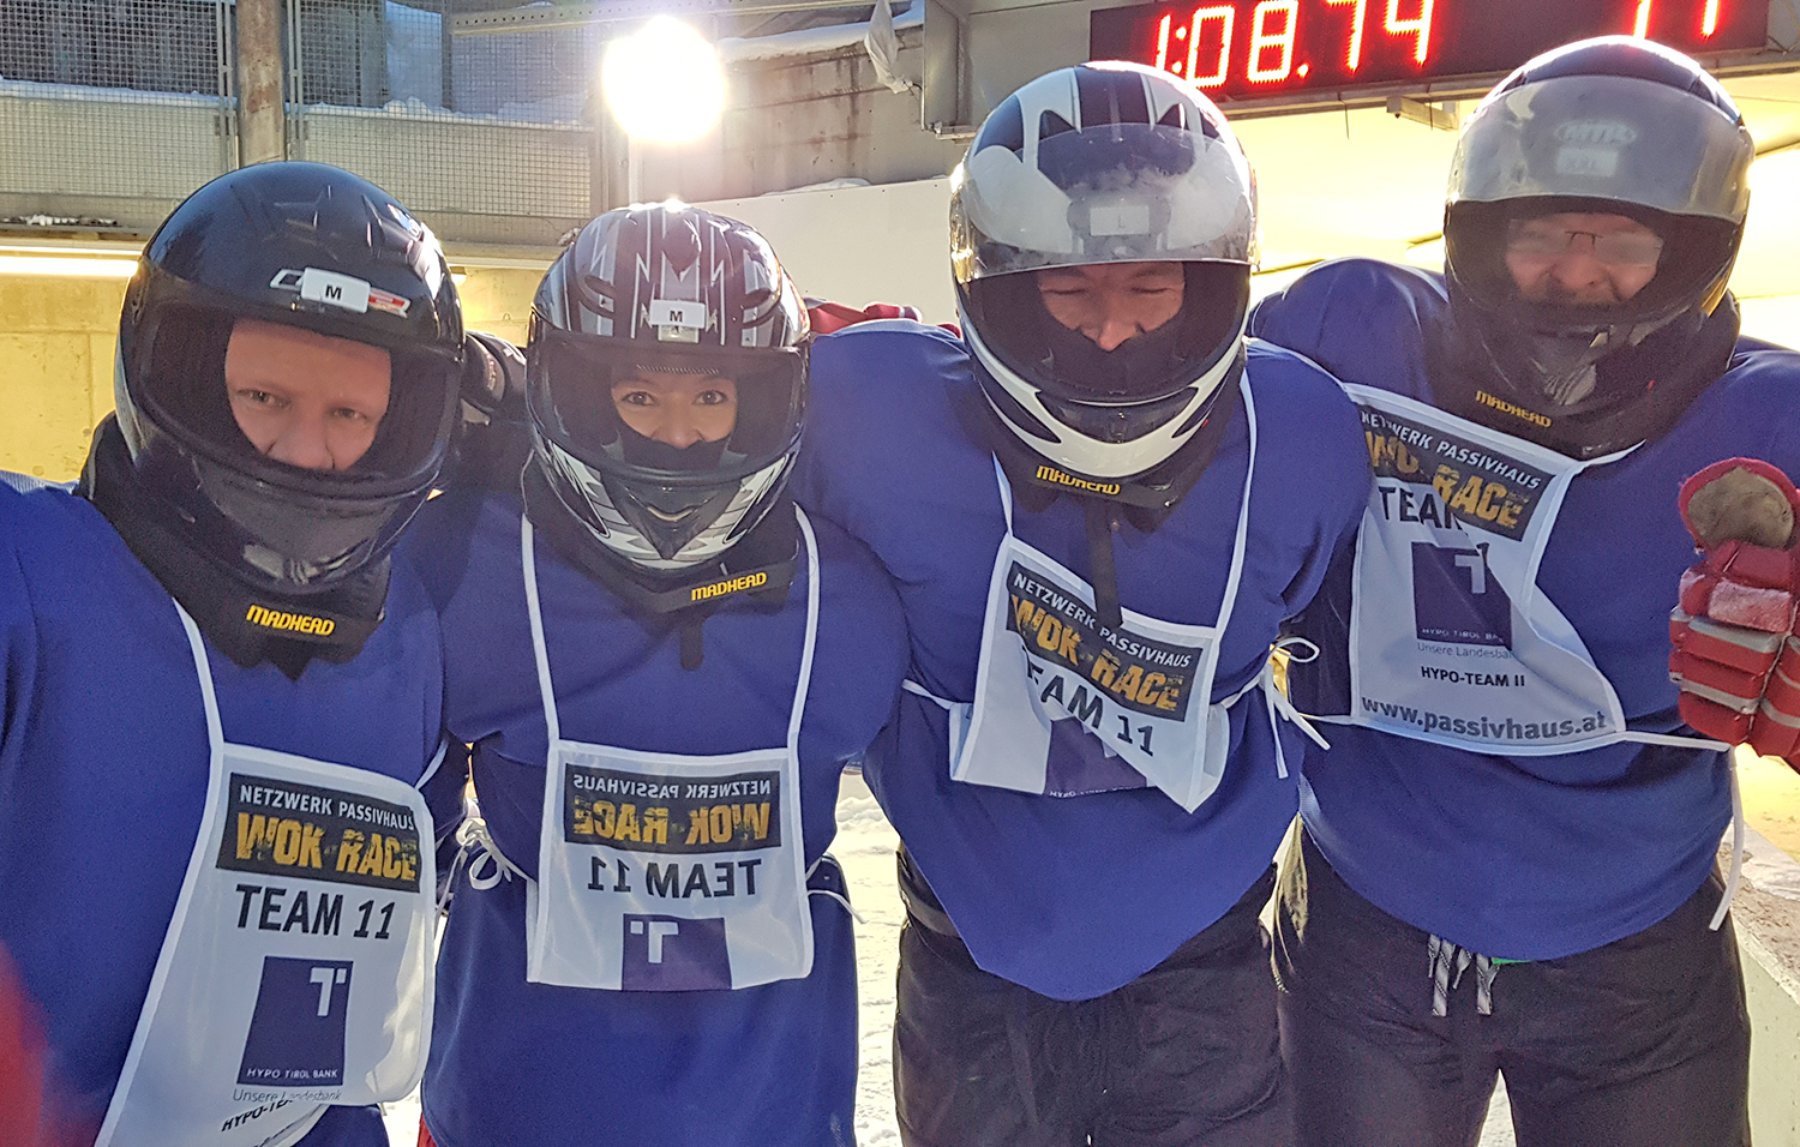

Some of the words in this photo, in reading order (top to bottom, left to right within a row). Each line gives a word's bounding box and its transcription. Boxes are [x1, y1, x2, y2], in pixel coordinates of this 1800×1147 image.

[325, 284, 342, 301] M
[669, 310, 684, 323] M
[1475, 389, 1552, 428] MADHEAD
[1361, 411, 1433, 449] NETWERK
[1436, 441, 1541, 489] PASSIVHAUS
[1365, 431, 1420, 474] WO
[1432, 464, 1529, 529] RACE
[690, 571, 768, 601] MADHEAD
[246, 604, 335, 636] MADHEAD
[1013, 572, 1097, 631] NETZWERK
[1099, 626, 1192, 668] PASSIVHAUS
[1422, 628, 1449, 638] HYPO
[1011, 594, 1082, 667] WOK
[1091, 648, 1185, 712] RACE
[1417, 642, 1454, 656] Unsere
[1456, 646, 1512, 659] Landesba
[1421, 666, 1510, 687] HYPO-TEAM
[1022, 645, 1104, 730] EAM
[1117, 714, 1154, 757] 11
[1362, 696, 1607, 742] www.passivhaus.at
[240, 784, 333, 816] NETZWERK
[339, 801, 415, 831] PASSIVHAUS
[235, 812, 326, 869] WOK
[336, 829, 417, 882] RACE
[236, 884, 344, 936] TEAM
[353, 900, 396, 940] 11
[247, 1068, 280, 1079] HYPO
[285, 1069, 310, 1079] TIROL
[313, 1069, 338, 1079] BANK
[233, 1089, 278, 1102] Unsere
